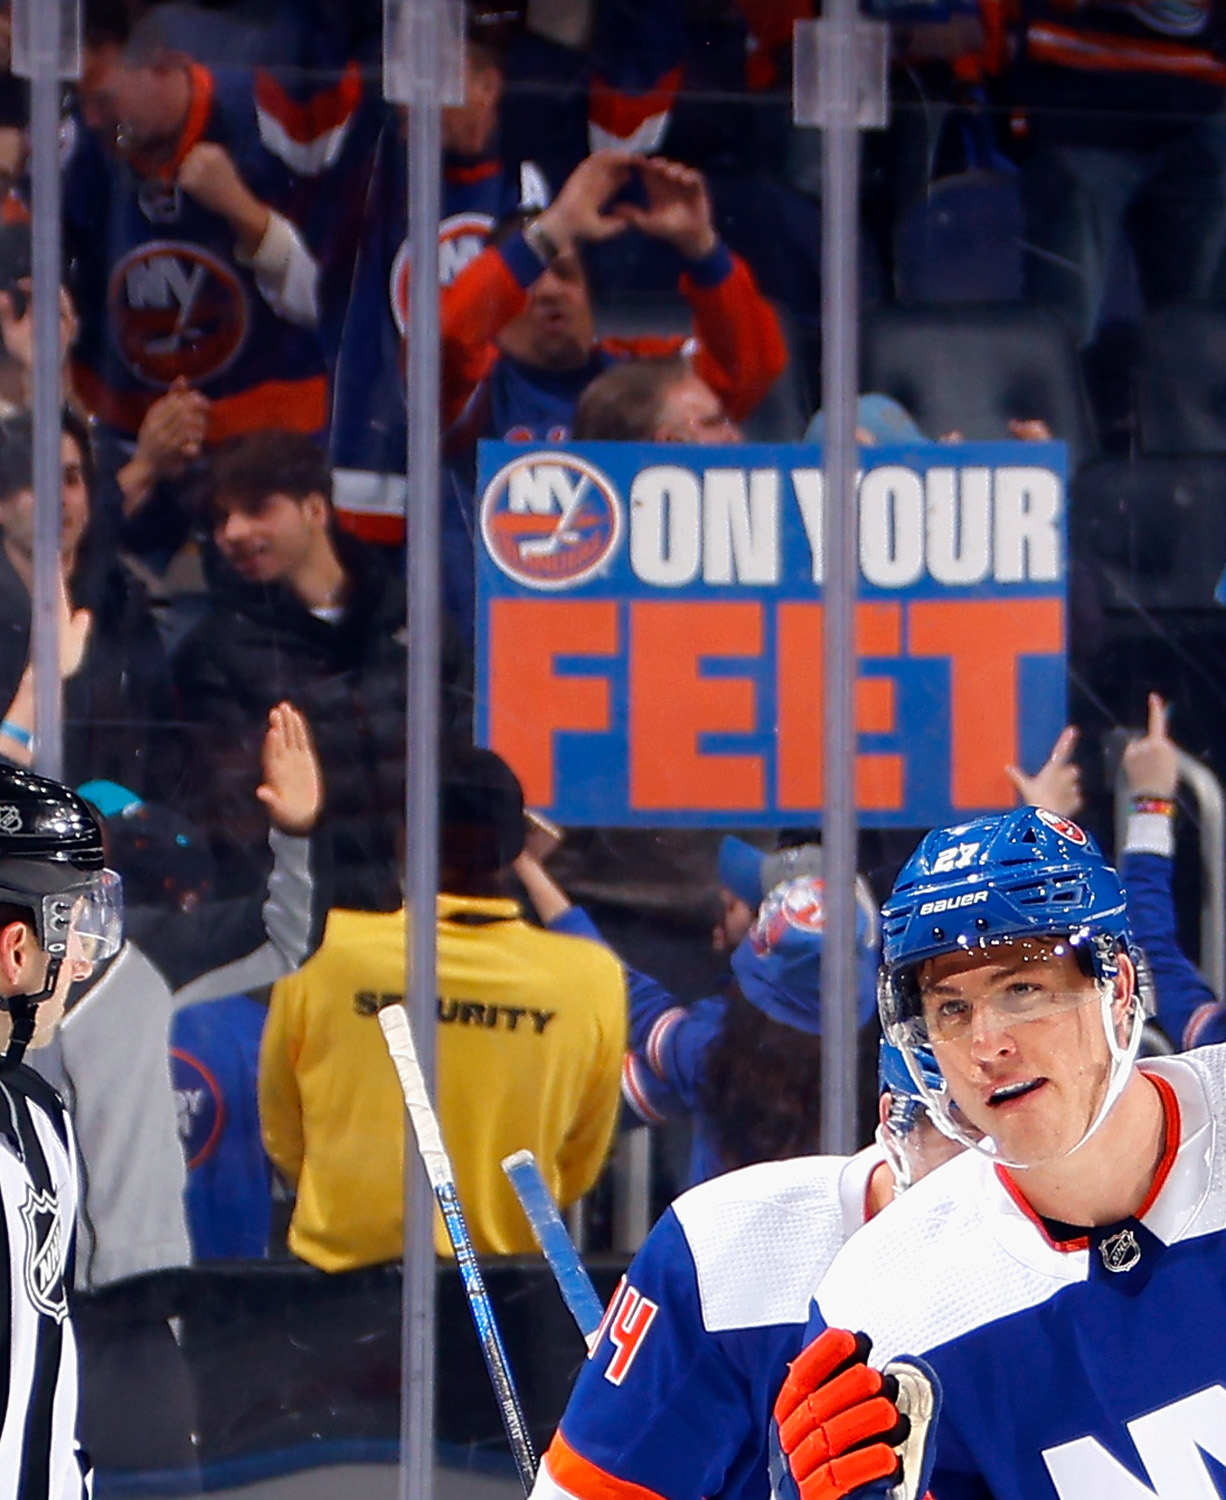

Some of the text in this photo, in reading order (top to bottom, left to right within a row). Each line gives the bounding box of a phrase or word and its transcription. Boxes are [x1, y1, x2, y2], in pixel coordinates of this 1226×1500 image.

[629, 465, 779, 587] ON
[488, 599, 1063, 810] FEET
[931, 842, 981, 876] 27
[354, 990, 557, 1035] SURITY
